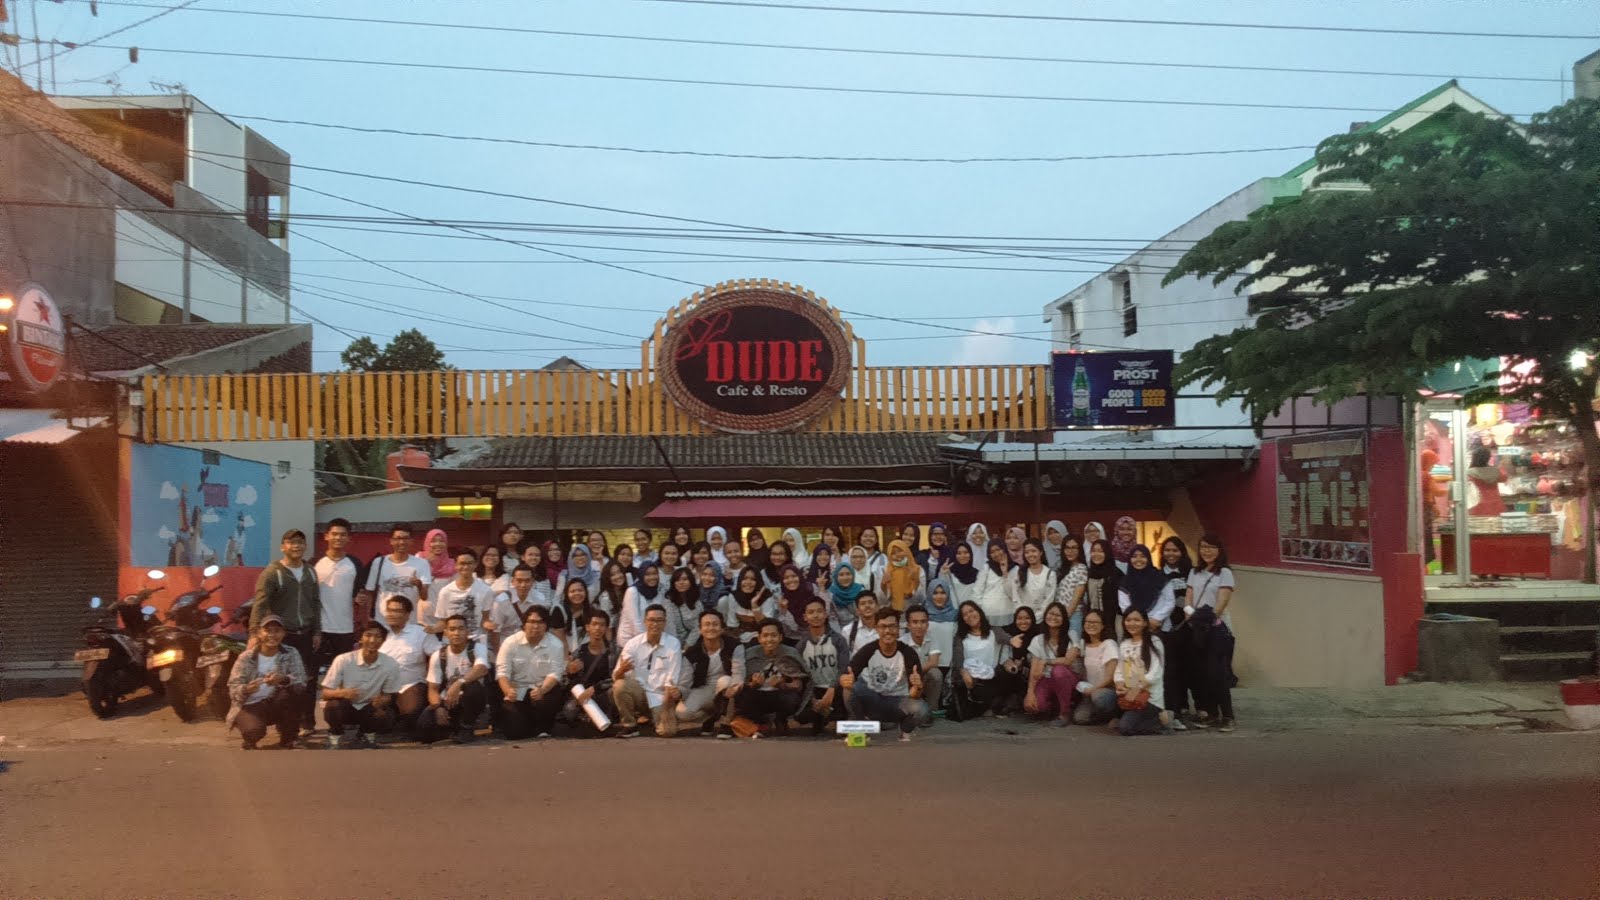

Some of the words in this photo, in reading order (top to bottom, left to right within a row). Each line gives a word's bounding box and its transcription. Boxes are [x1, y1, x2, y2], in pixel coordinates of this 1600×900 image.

[705, 340, 823, 382] DUDE
[1113, 369, 1159, 380] PROST
[716, 384, 749, 396] Cafe
[752, 384, 765, 396] &
[769, 384, 808, 396] Resto
[1108, 389, 1134, 398] GOOD
[1101, 398, 1135, 407] PEOPLE
[808, 654, 836, 671] NYC
